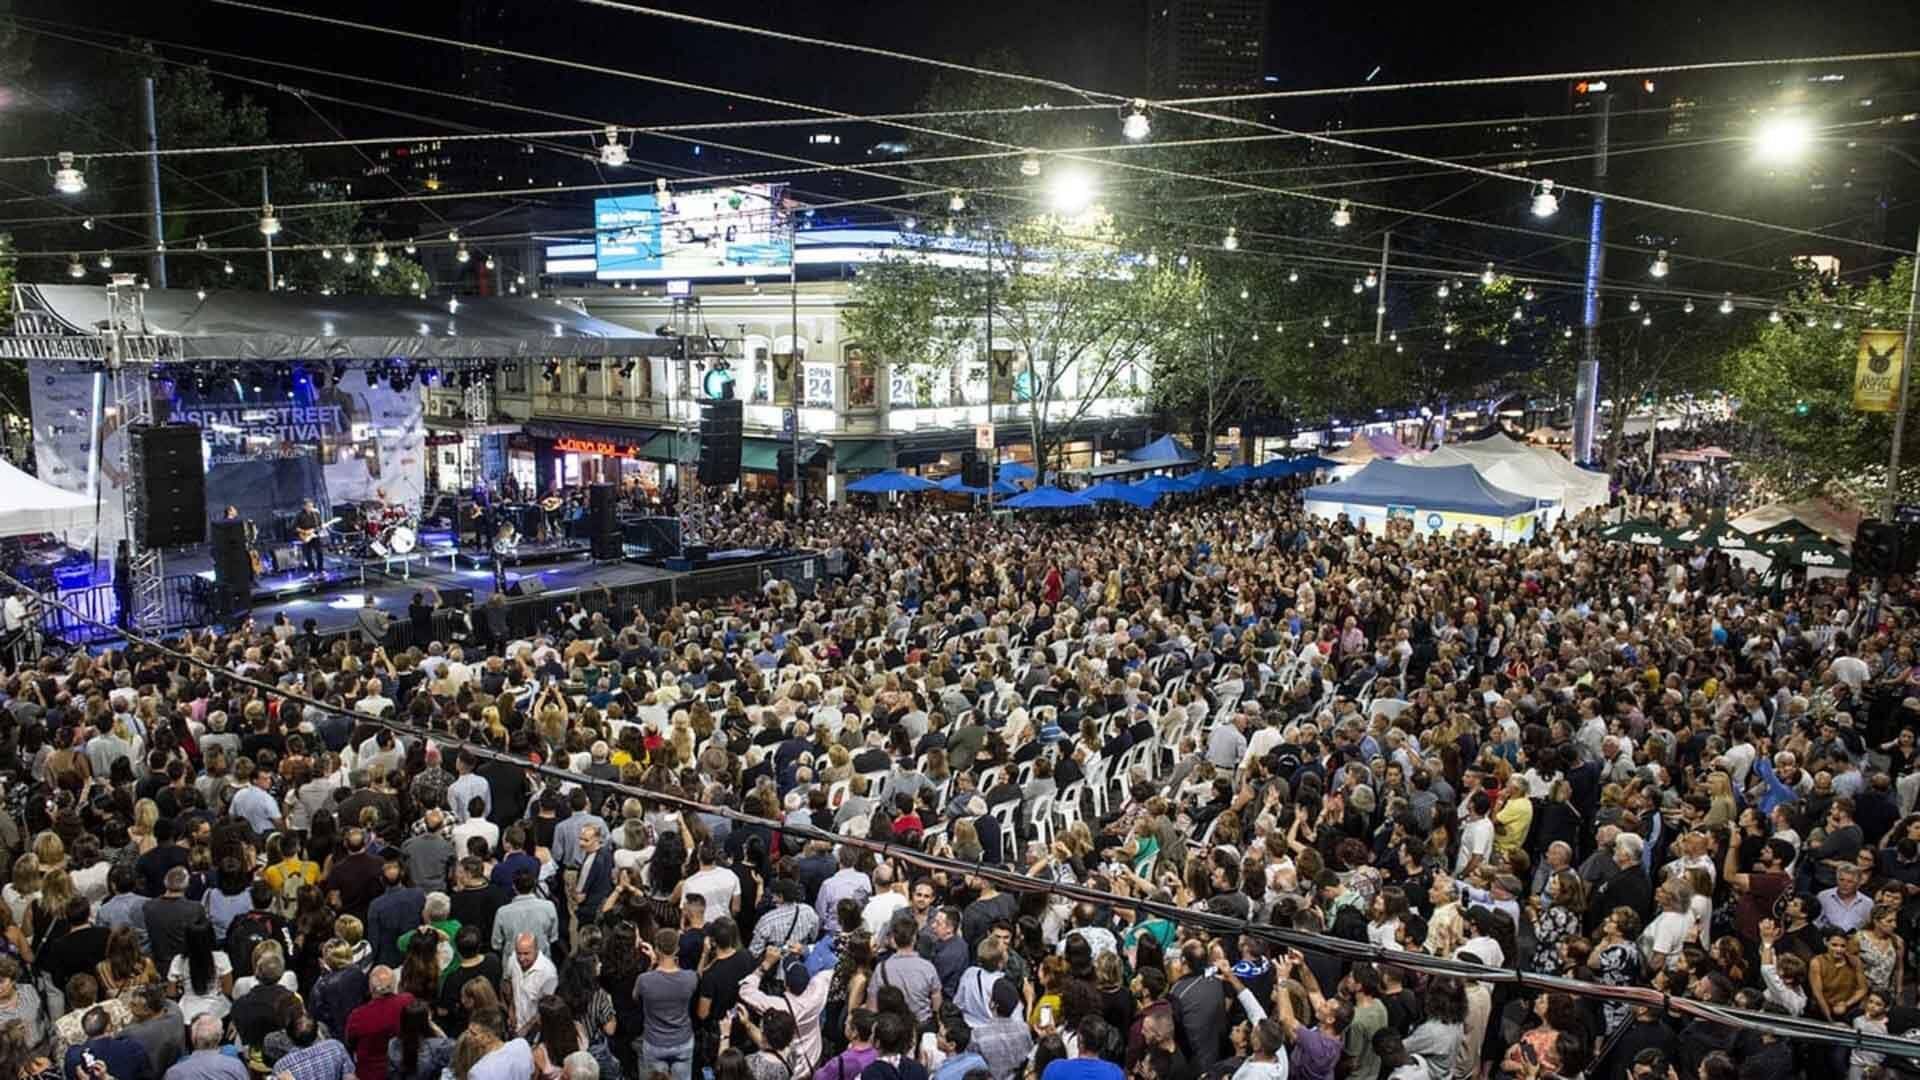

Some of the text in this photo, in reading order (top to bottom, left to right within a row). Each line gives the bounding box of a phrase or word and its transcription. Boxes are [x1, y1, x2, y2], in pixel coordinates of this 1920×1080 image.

[808, 367, 832, 378] OPEN
[808, 378, 833, 398] 24
[892, 379, 914, 399] 24
[264, 406, 342, 425] STREET
